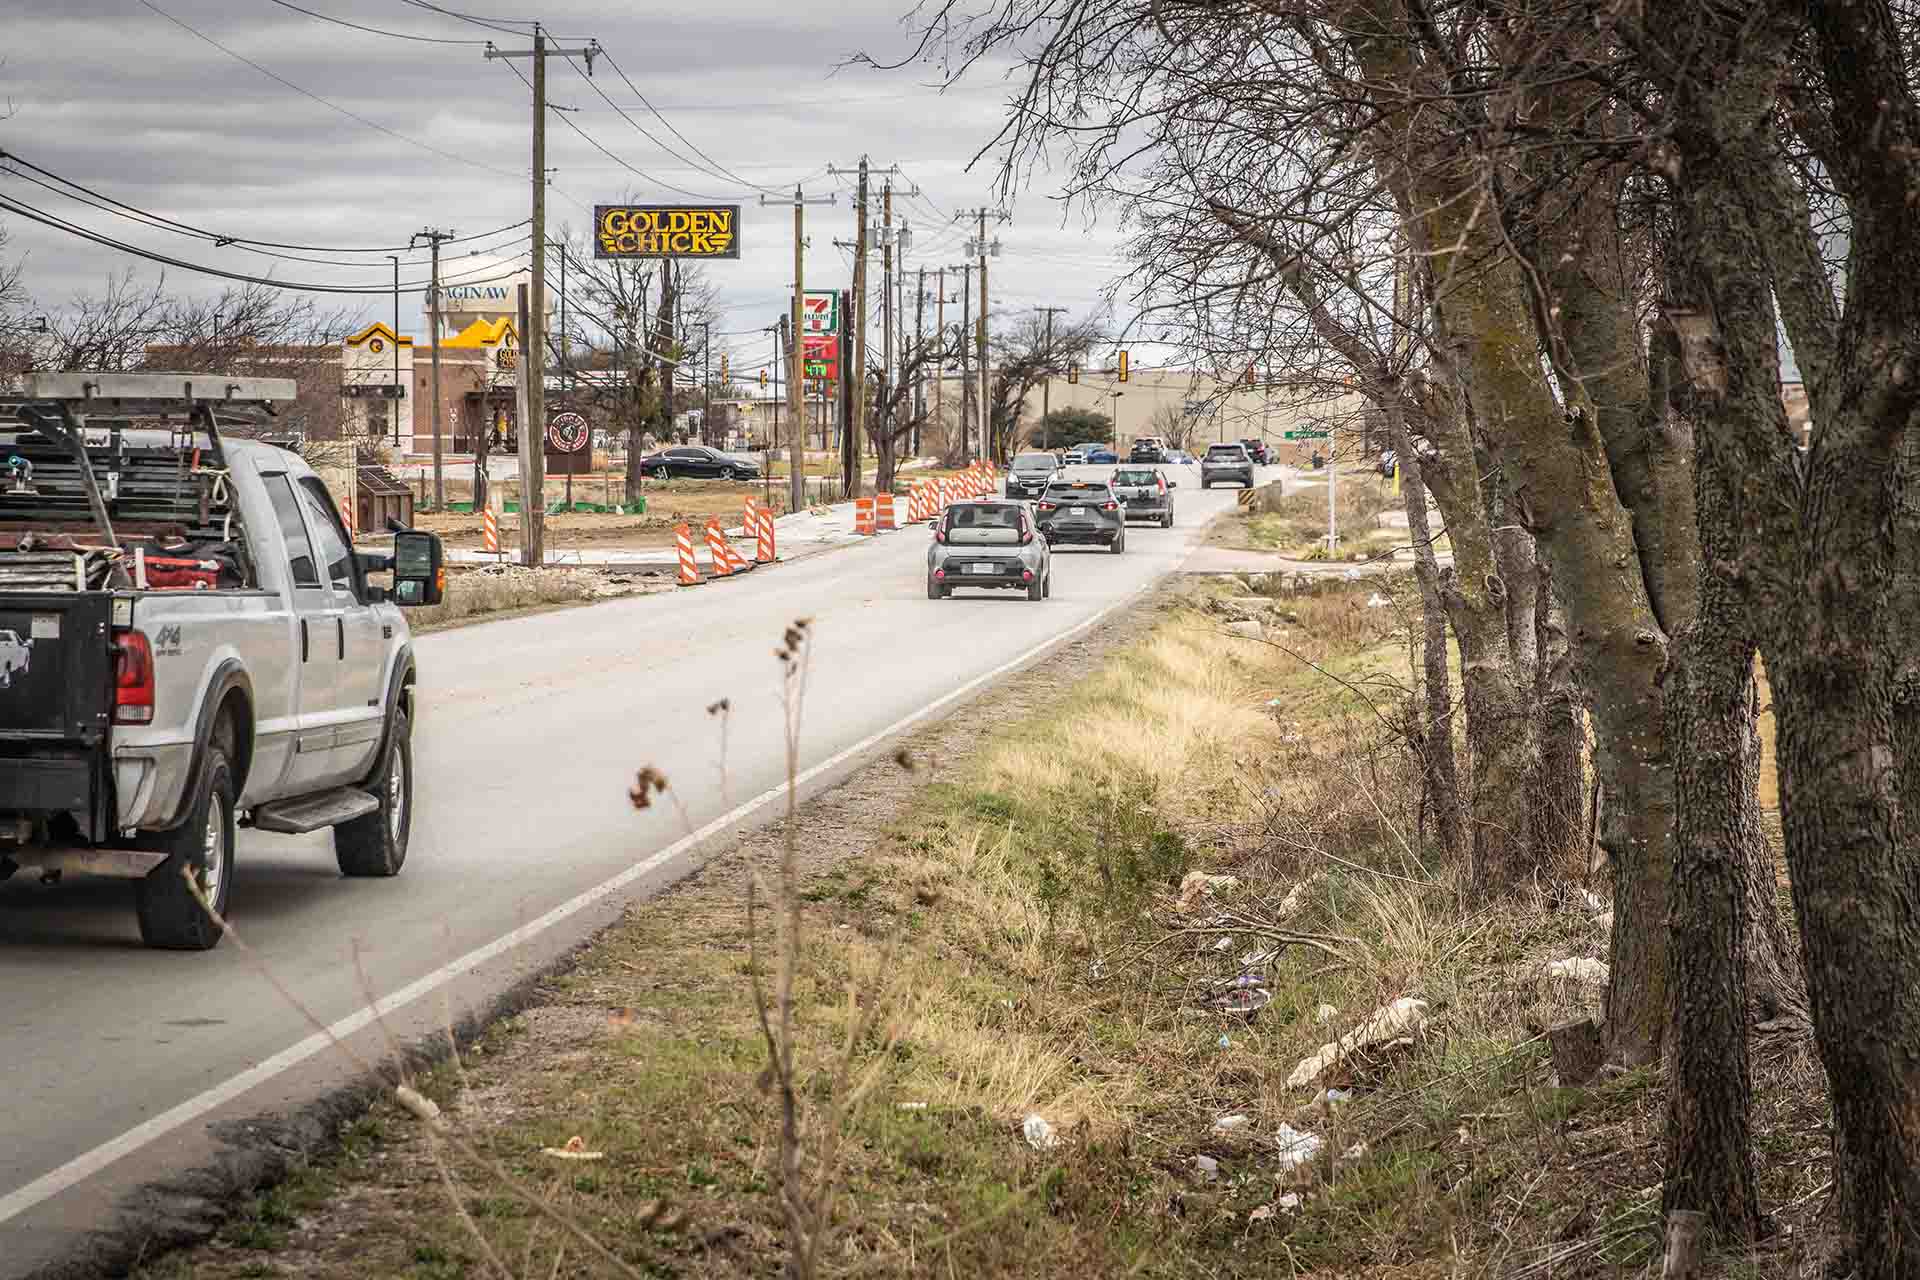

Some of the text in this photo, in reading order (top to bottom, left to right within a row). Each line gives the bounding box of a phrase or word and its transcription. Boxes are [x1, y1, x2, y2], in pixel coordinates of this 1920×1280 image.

[604, 211, 730, 235] GOLDEN
[616, 232, 714, 252] CHICK
[805, 298, 828, 330] 7
